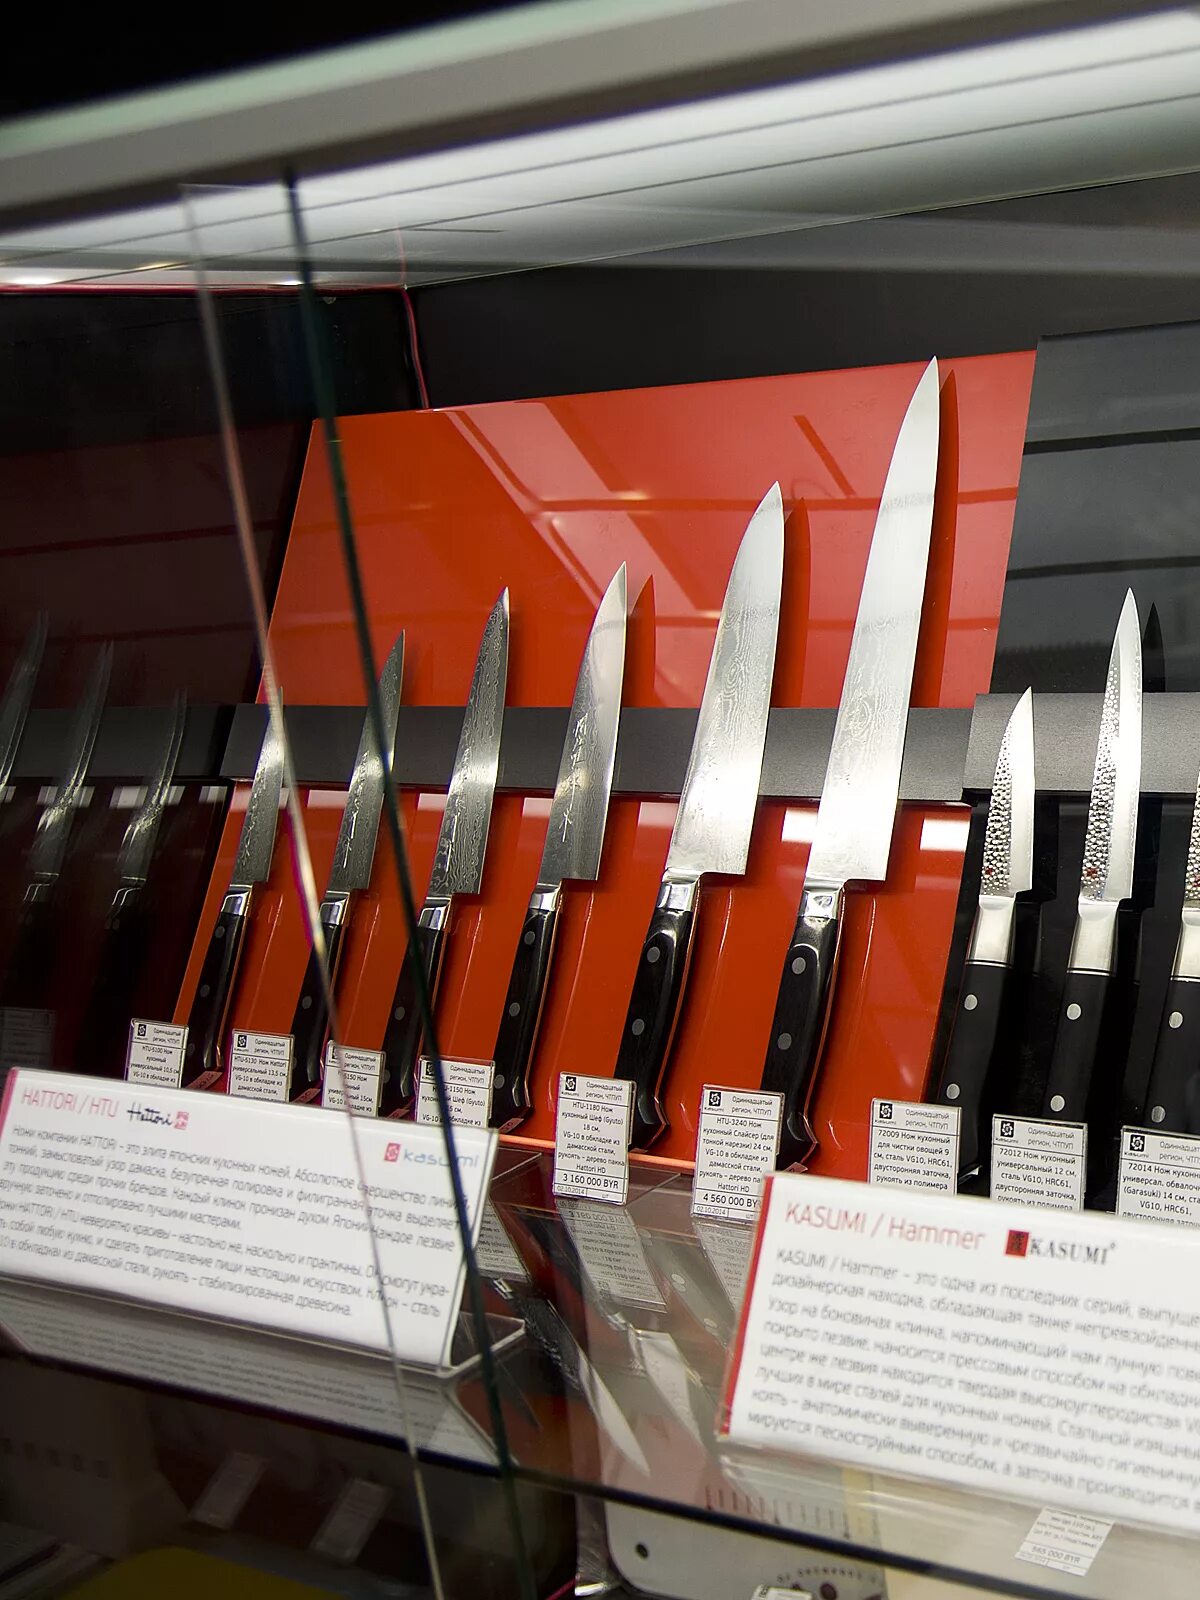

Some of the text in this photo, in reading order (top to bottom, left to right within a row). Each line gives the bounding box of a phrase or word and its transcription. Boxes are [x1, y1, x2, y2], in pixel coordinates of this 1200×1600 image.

[21, 1088, 119, 1118] HATTORI / HTU
[562, 1111, 589, 1120] кухонный
[589, 1114, 602, 1122] Шеф
[716, 1117, 762, 1128] HTU-3240 Нож
[703, 1127, 733, 1136] кухонный
[733, 1129, 759, 1141] Слайсер
[878, 1129, 951, 1144] 72009 Нож кухонный
[702, 1137, 724, 1146] тонкой
[891, 1143, 915, 1151] чистки
[916, 1146, 943, 1155] овощей
[944, 1148, 950, 1156] 9
[999, 1147, 1076, 1165] 72012 Нож кухонный
[885, 1153, 904, 1161] сталь
[576, 1164, 606, 1174] Hattori HD
[873, 1163, 921, 1175] двусторонняя
[996, 1160, 1053, 1173] универсальный
[1054, 1167, 1064, 1175] 12
[1128, 1162, 1152, 1172] 72014
[1154, 1165, 1171, 1175] Нож
[563, 1173, 619, 1189] 3 160 000 BYR
[876, 1175, 903, 1184] рукоять
[913, 1179, 948, 1191] полимера
[1000, 1172, 1021, 1181] сталь
[717, 1182, 750, 1193] Hattori HD
[1123, 1186, 1161, 1199] (Garasuki)
[1163, 1191, 1173, 1199] 14
[703, 1193, 760, 1208] 4 560 000 BY
[785, 1201, 867, 1233] KASUMI
[870, 1212, 885, 1238] /
[889, 1217, 985, 1251] Hammer
[776, 1247, 827, 1269] KASUMI
[841, 1259, 899, 1280] Hammer
[913, 1270, 939, 1286] это
[940, 1275, 977, 1293] одна
